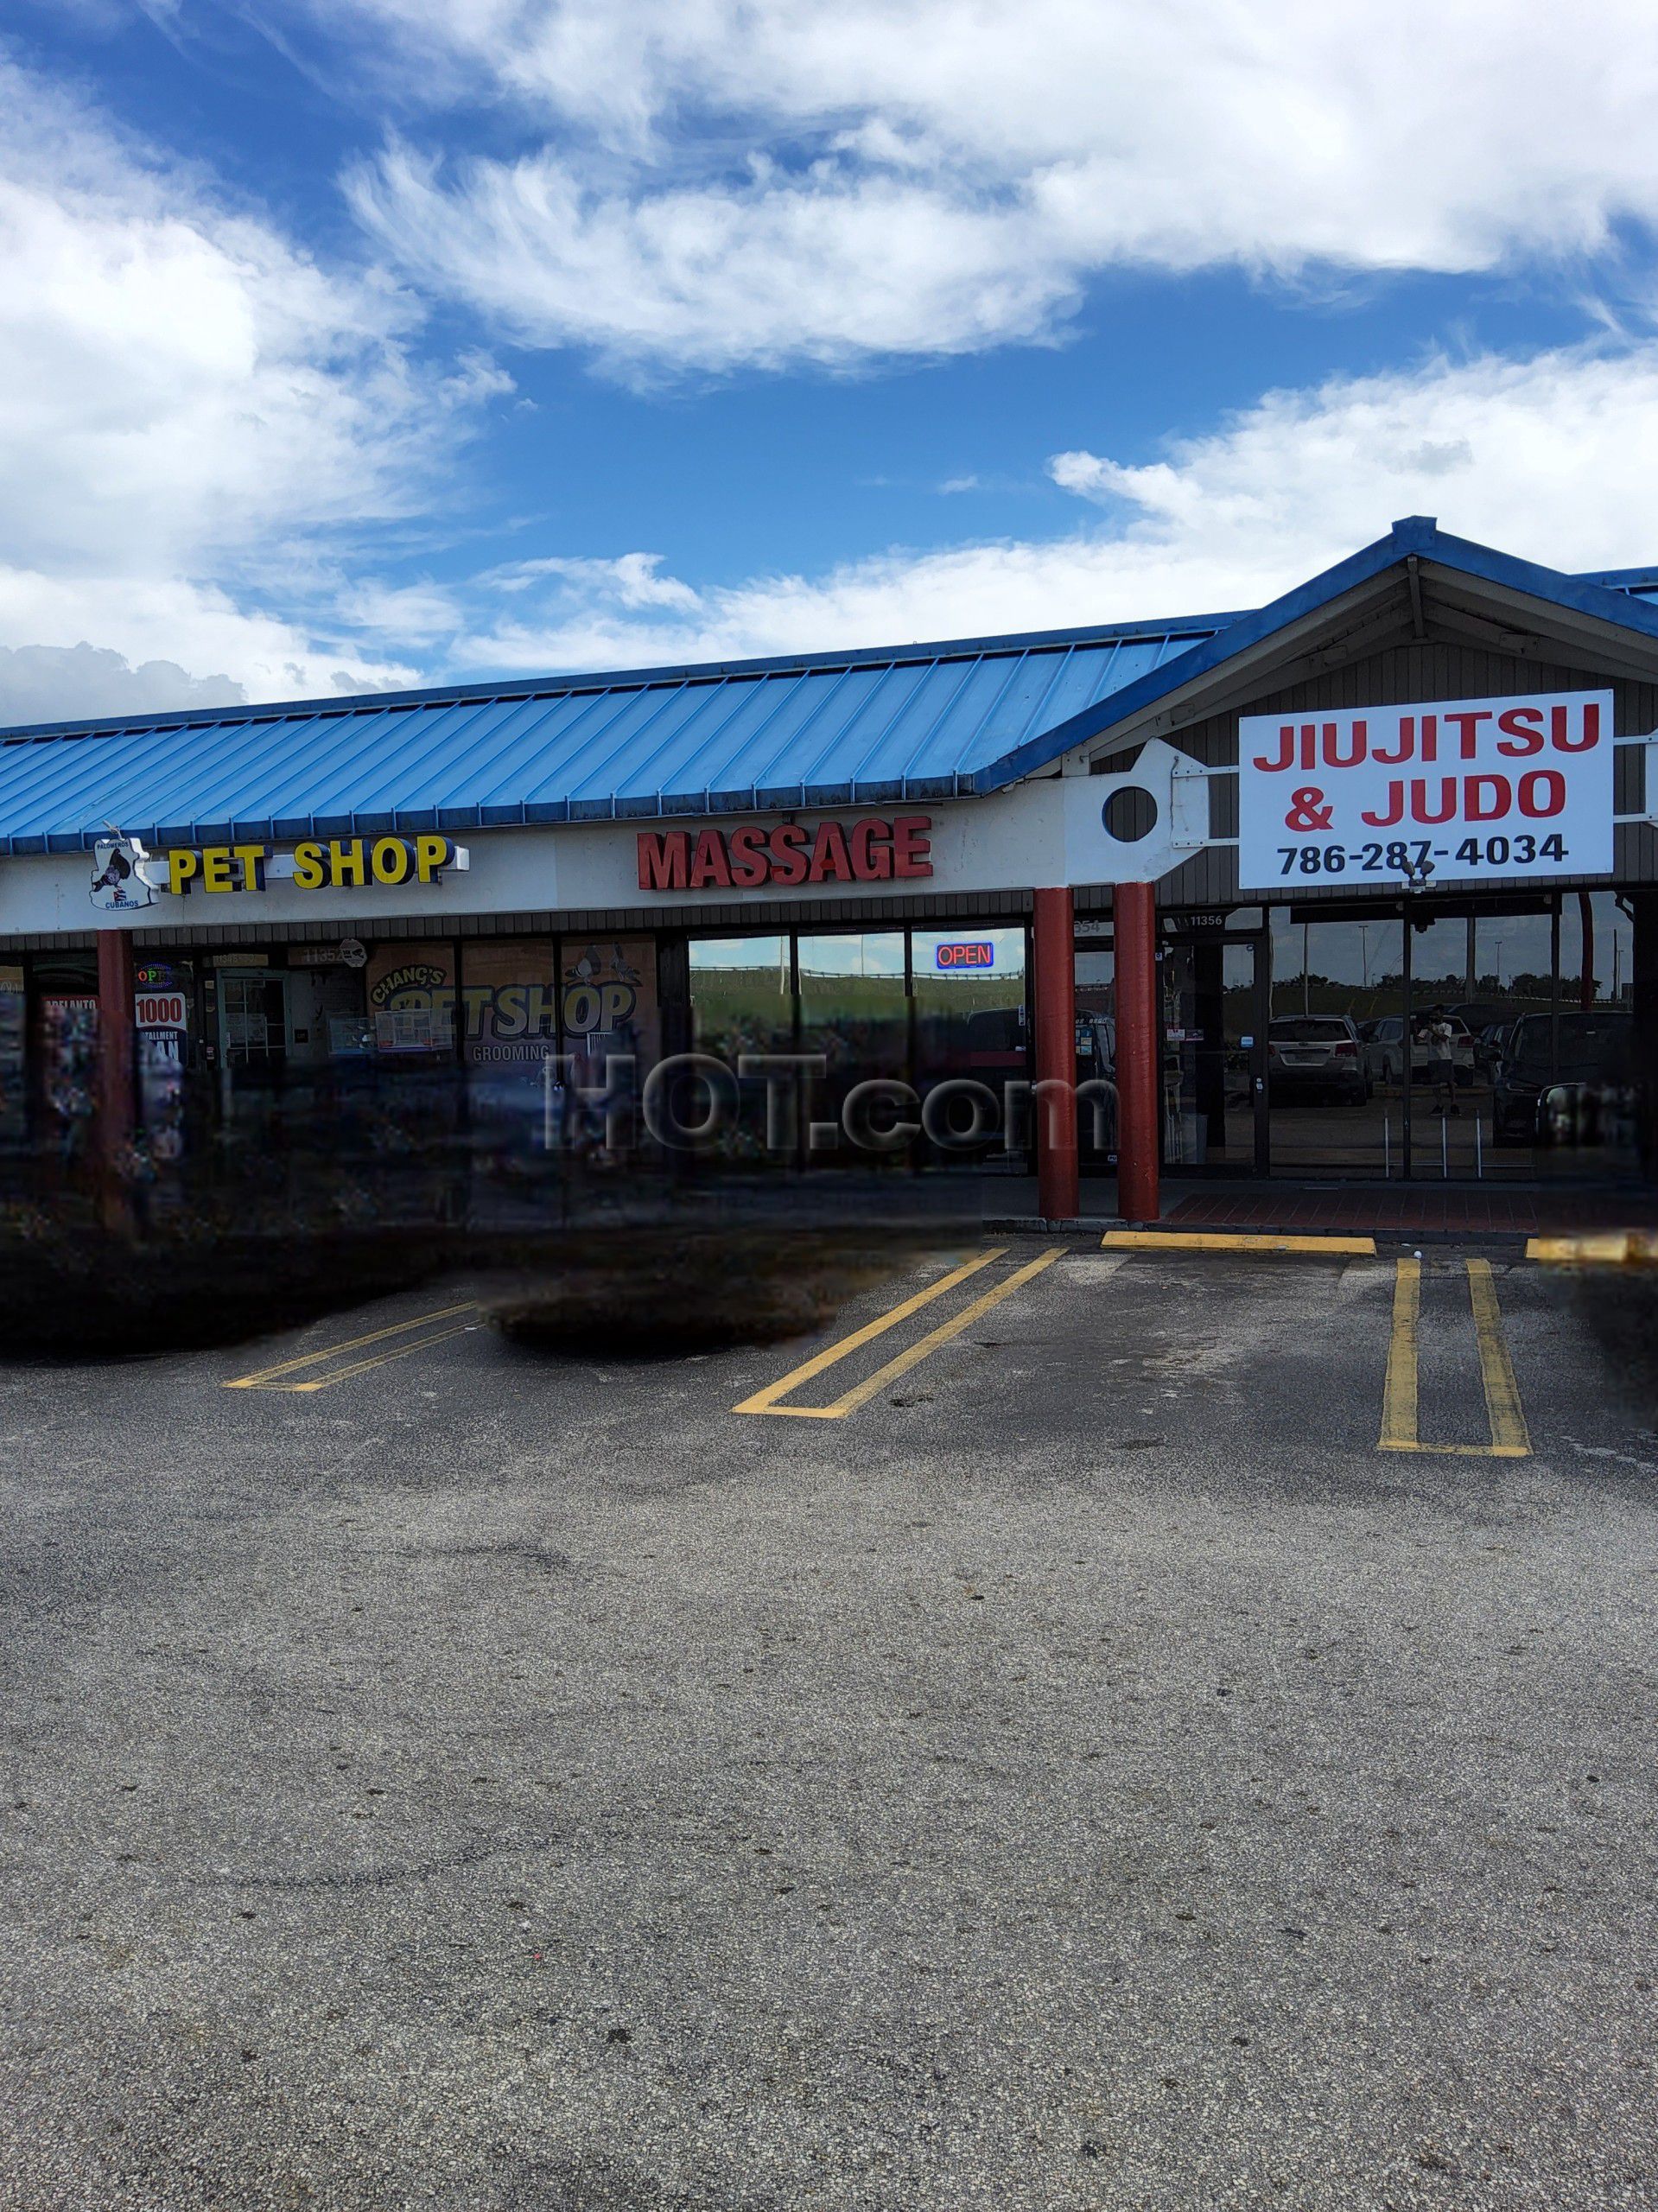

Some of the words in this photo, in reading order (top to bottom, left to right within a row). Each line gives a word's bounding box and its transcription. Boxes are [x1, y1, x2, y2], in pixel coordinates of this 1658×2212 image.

[1253, 703, 1598, 772] JIUJITSU
[1285, 786, 1333, 832] &
[1361, 769, 1565, 827] JUDO
[168, 845, 271, 894] PET
[293, 836, 454, 889] SHOP
[638, 817, 932, 889] MASSAGE
[1277, 833, 1568, 874] 786-287-4034
[105, 900, 138, 909] CUBANOS
[1074, 919, 1100, 932] 354
[1191, 915, 1223, 926] 11356
[938, 945, 990, 965] OPEN
[372, 966, 445, 1004] CHANG'S
[137, 998, 181, 1022] 1000
[473, 1045, 549, 1061] GROOMING
